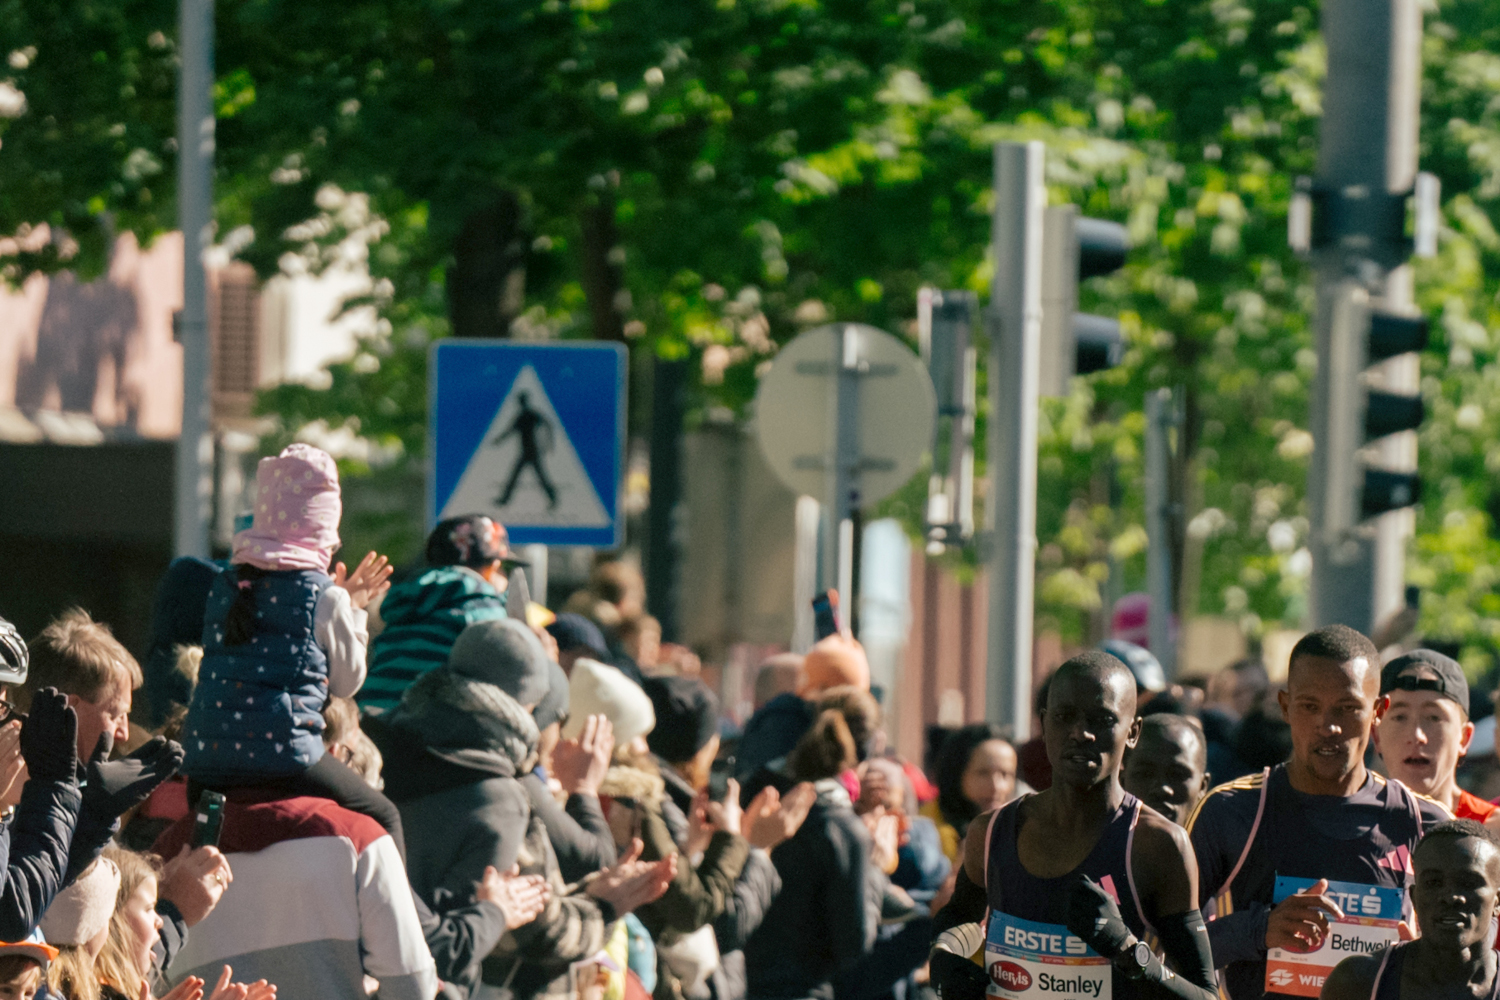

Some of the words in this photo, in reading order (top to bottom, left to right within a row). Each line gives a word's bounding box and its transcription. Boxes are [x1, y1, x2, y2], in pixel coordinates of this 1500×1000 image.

[1004, 925, 1062, 953] ERSTE
[993, 964, 1029, 986] Hervis
[1038, 972, 1103, 998] Stanley
[1299, 974, 1326, 988] WIE
